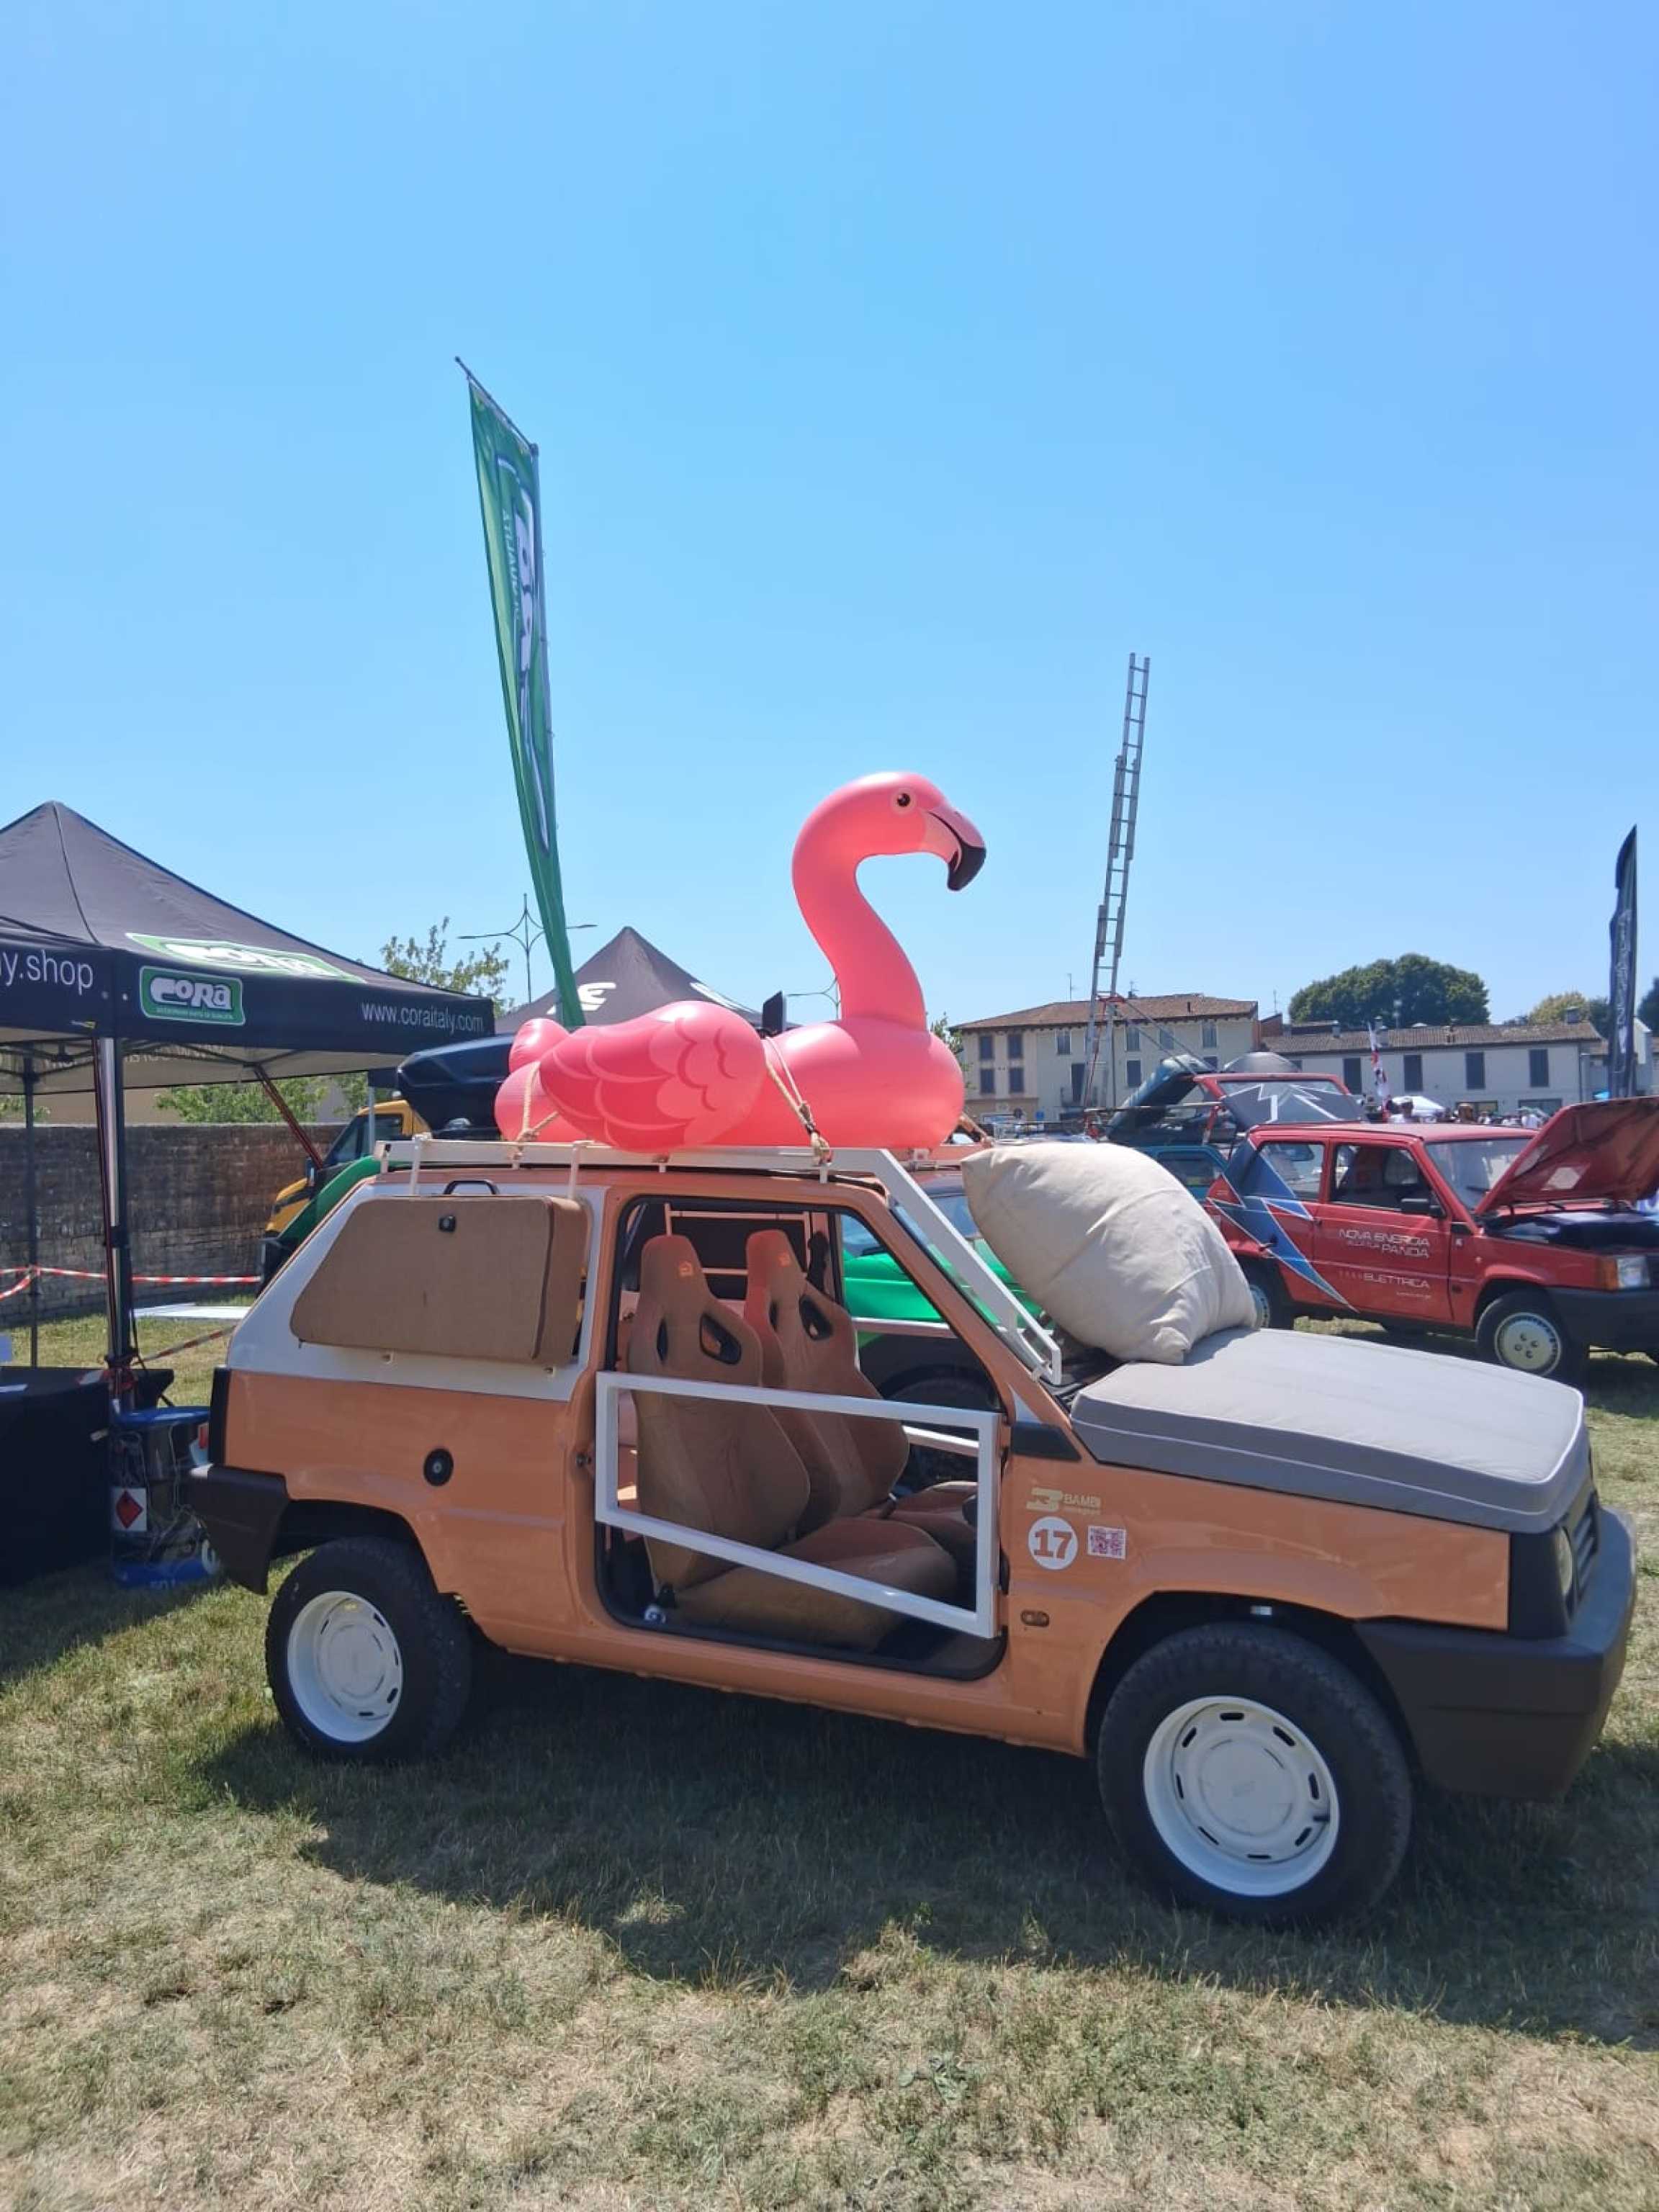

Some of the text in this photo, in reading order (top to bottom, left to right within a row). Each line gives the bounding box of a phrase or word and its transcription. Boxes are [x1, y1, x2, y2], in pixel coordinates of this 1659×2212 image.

[0, 949, 93, 995] y.shop
[1381, 1244, 1429, 1259] PANDA
[1033, 1528, 1074, 1560] 17
